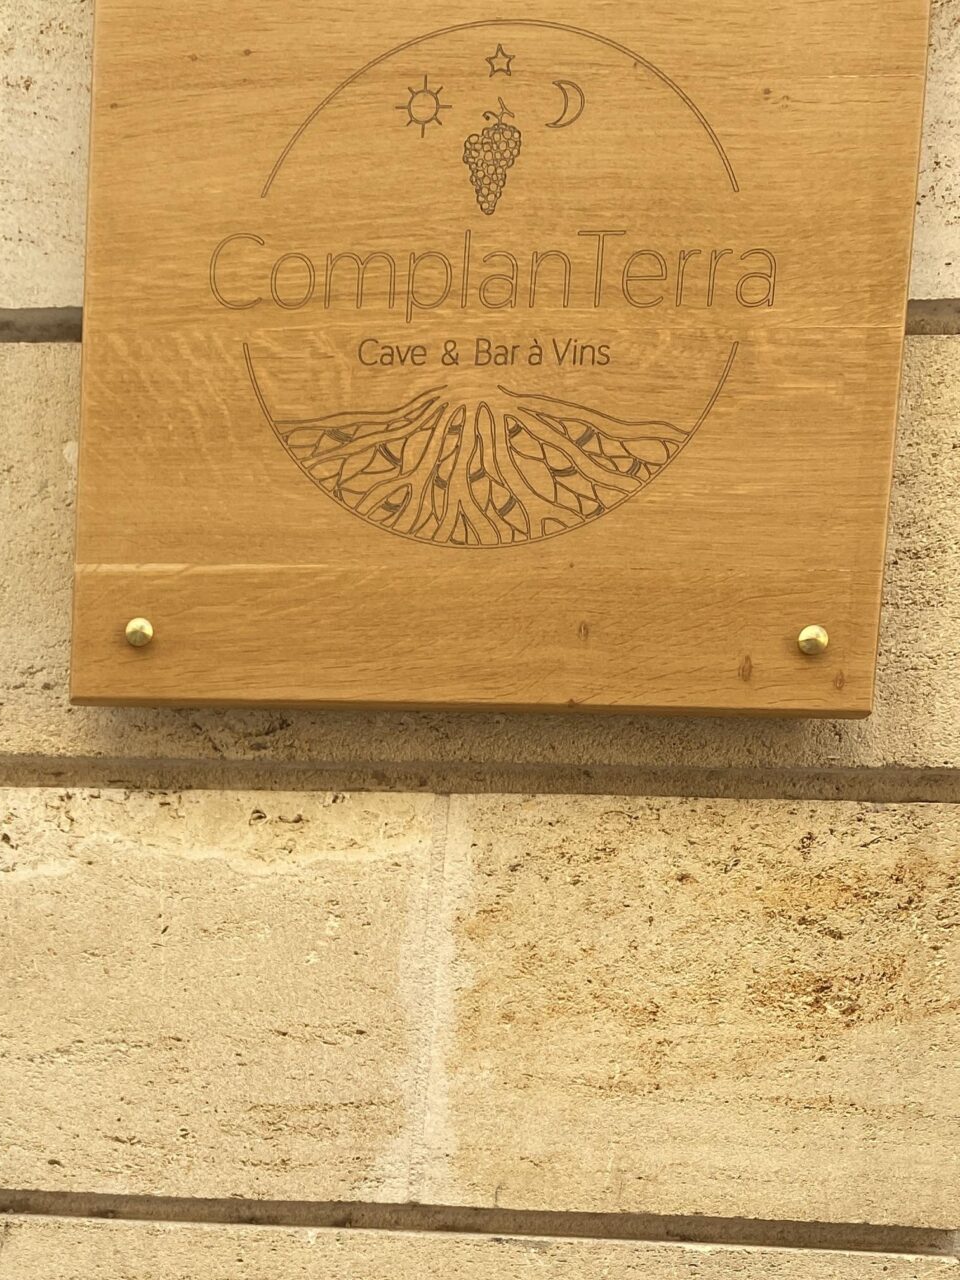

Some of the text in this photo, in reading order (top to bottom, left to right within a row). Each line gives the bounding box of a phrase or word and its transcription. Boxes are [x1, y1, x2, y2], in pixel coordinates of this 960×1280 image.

[210, 230, 776, 323] ComplanTerra
[357, 338, 611, 367] Cave & Bar à Vins
